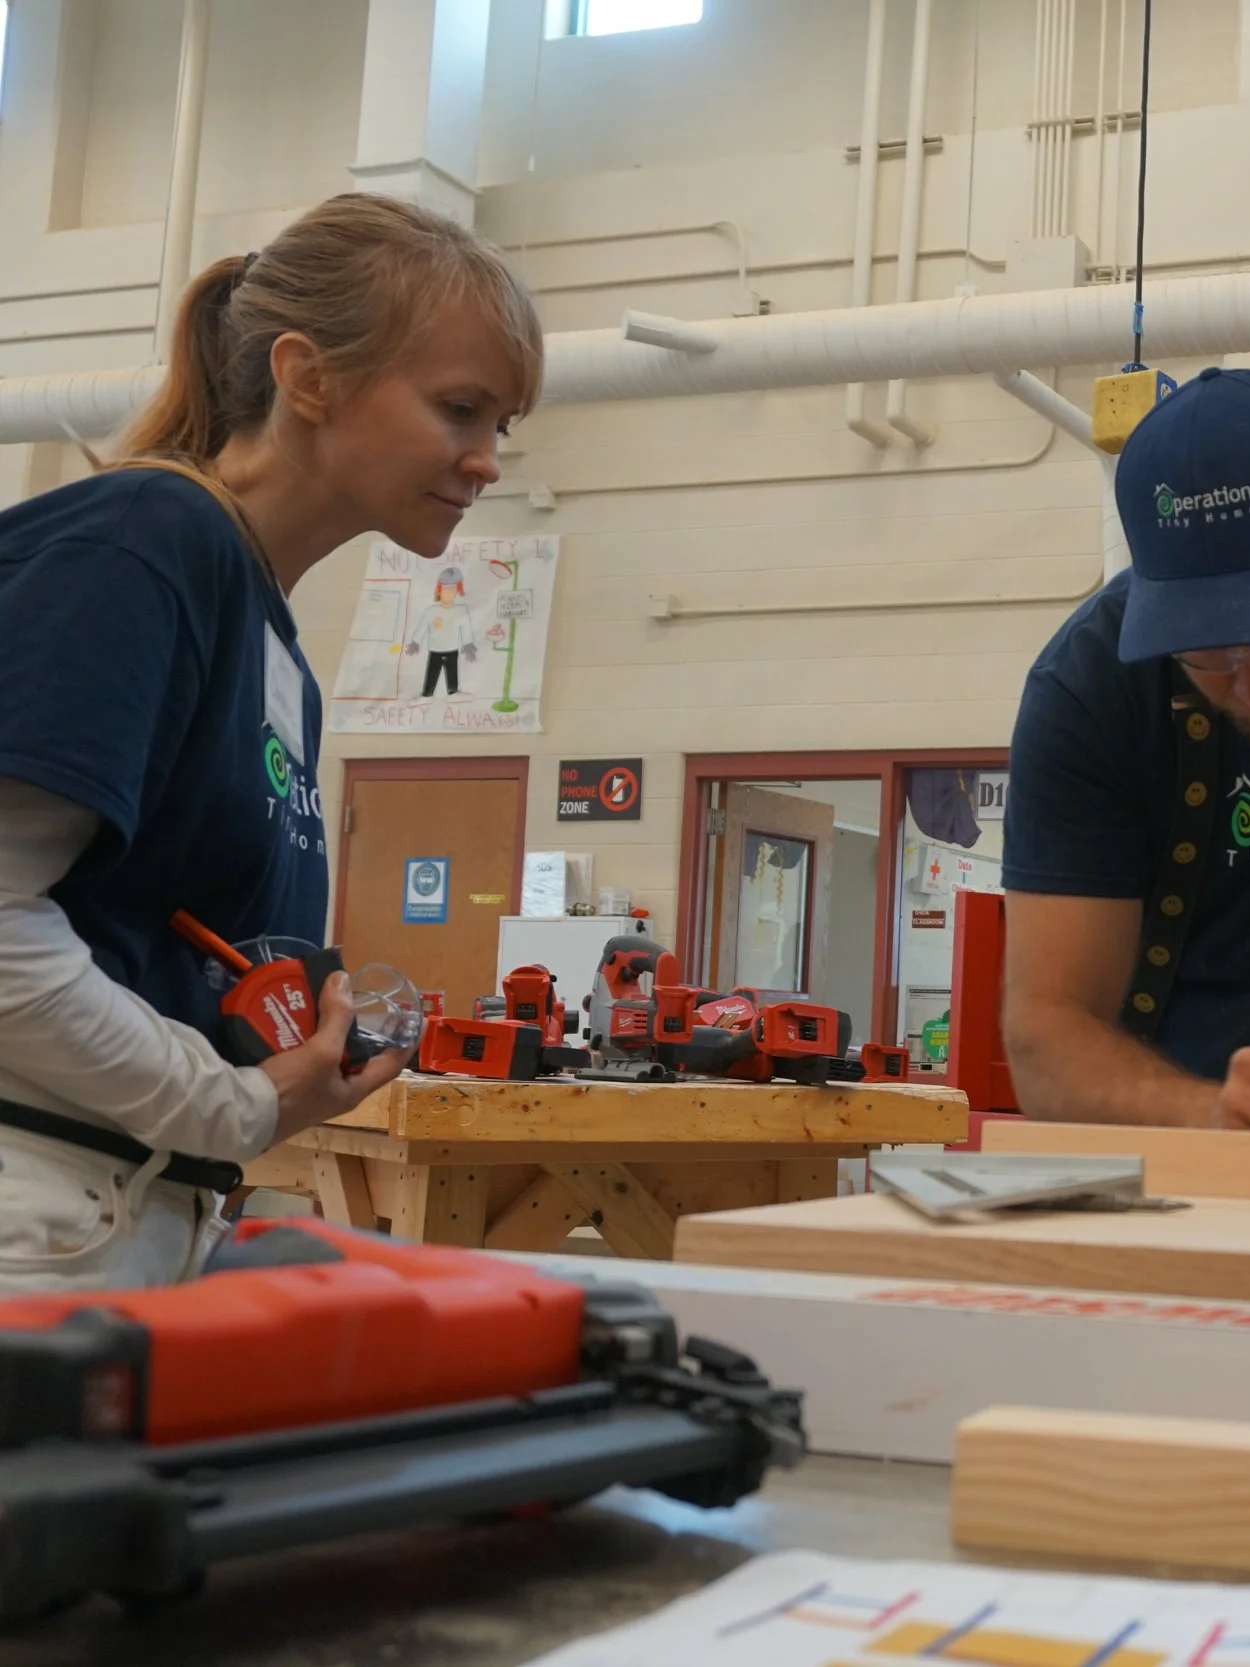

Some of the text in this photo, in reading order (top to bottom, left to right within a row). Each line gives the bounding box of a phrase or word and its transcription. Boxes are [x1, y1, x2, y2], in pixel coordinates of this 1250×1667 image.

[363, 705, 430, 727] SAFETY
[562, 769, 577, 781] NO
[561, 785, 598, 798] PHONE
[979, 782, 1004, 807] D1
[559, 801, 589, 814] ZONE
[289, 828, 326, 855] Hom
[286, 989, 306, 1011] 25
